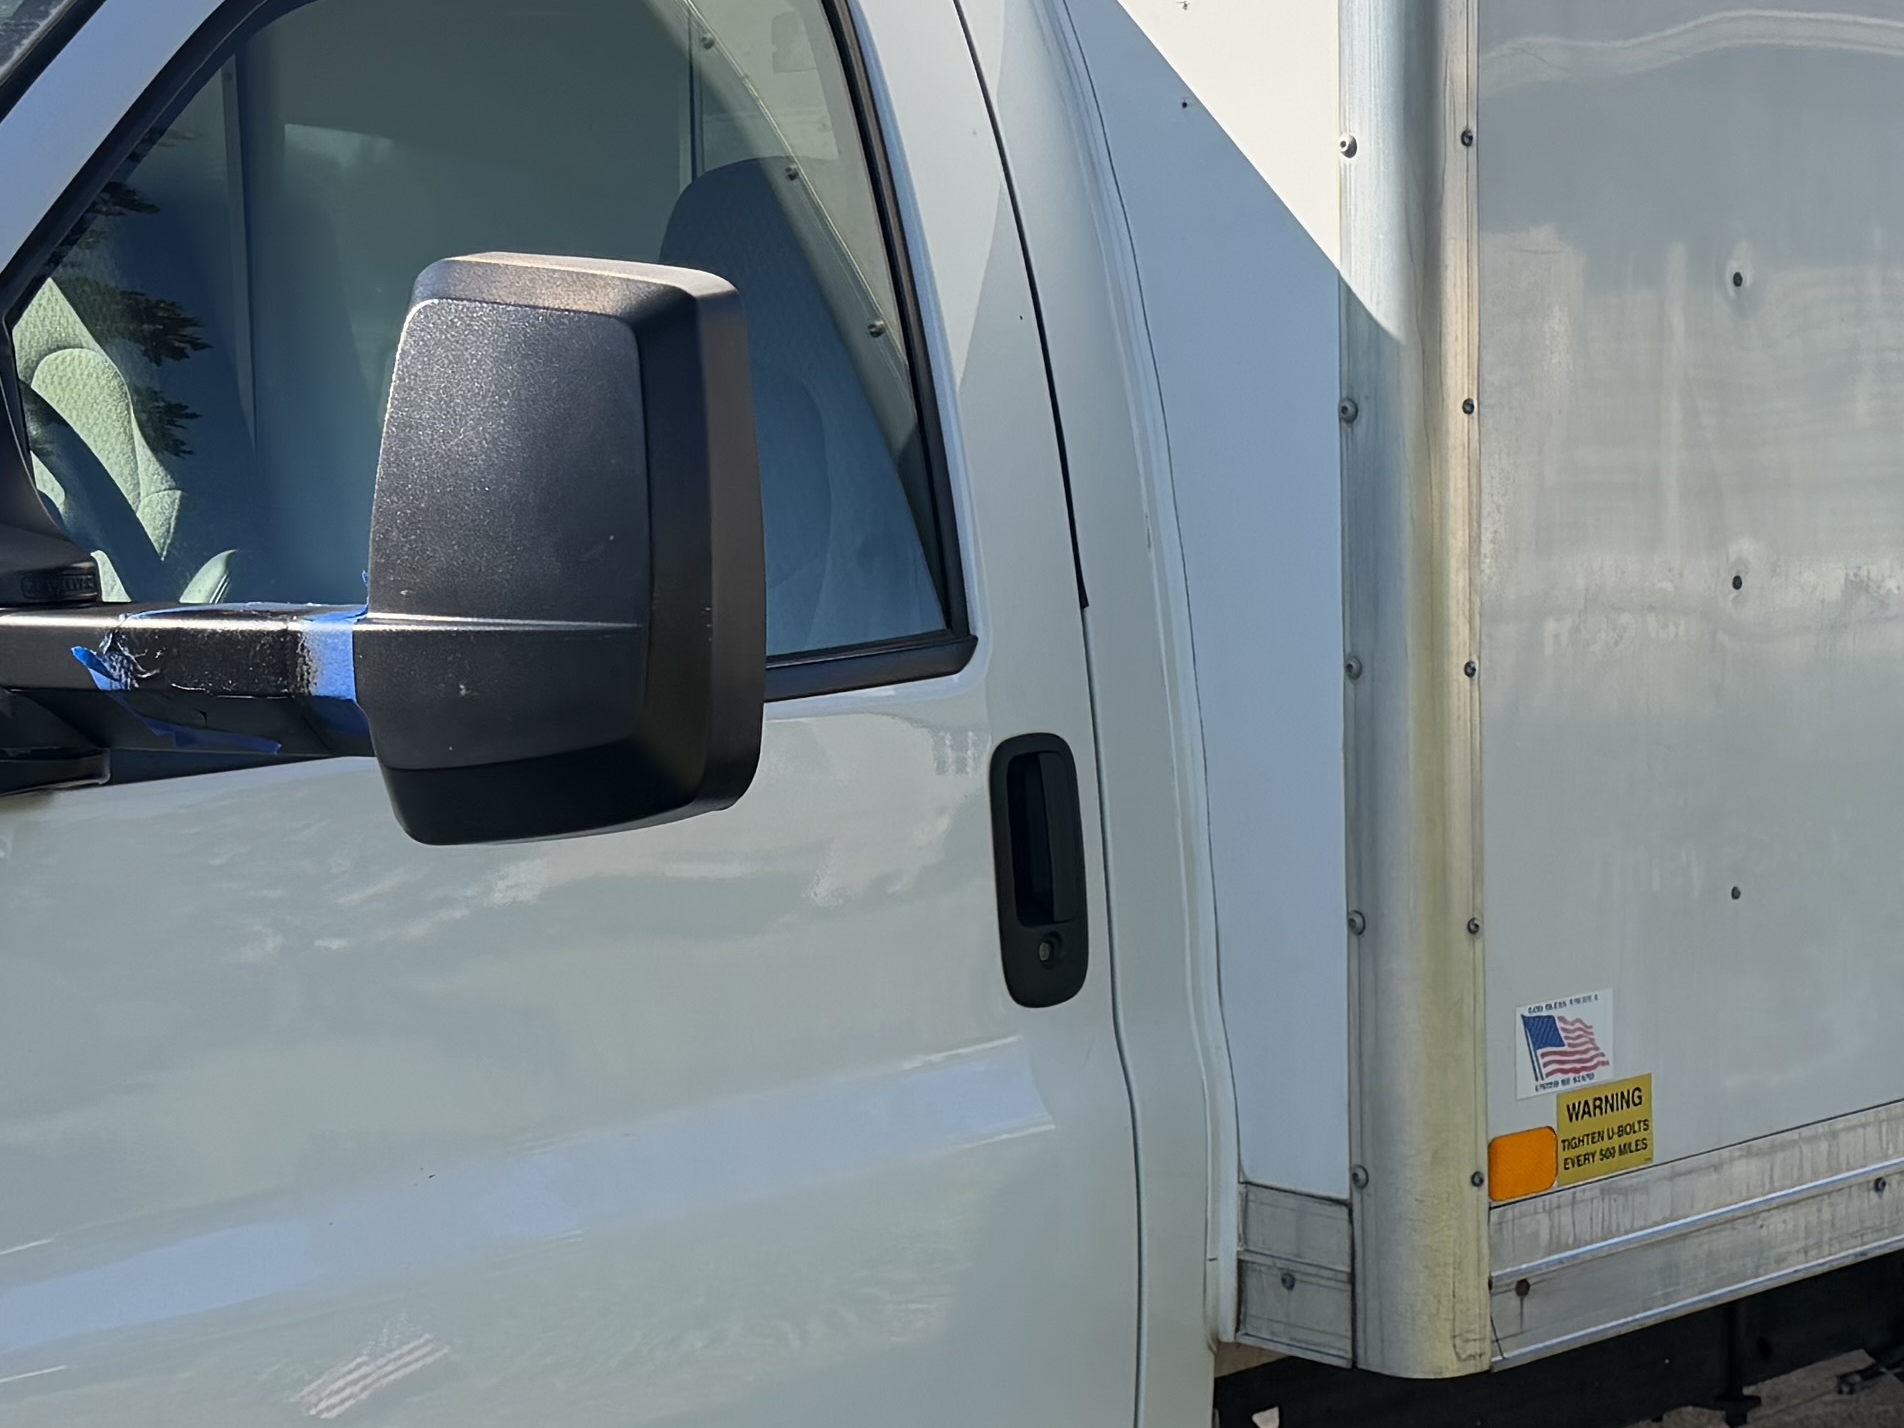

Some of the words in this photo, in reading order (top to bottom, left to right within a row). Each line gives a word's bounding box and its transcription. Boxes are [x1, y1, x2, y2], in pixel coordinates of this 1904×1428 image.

[1566, 1086, 1643, 1122] WARNING
[1561, 1130, 1604, 1152] TIGHTEN
[1607, 1118, 1650, 1141] U-BOLTS
[1563, 1150, 1597, 1171] EVERY
[1618, 1137, 1648, 1157] MILES
